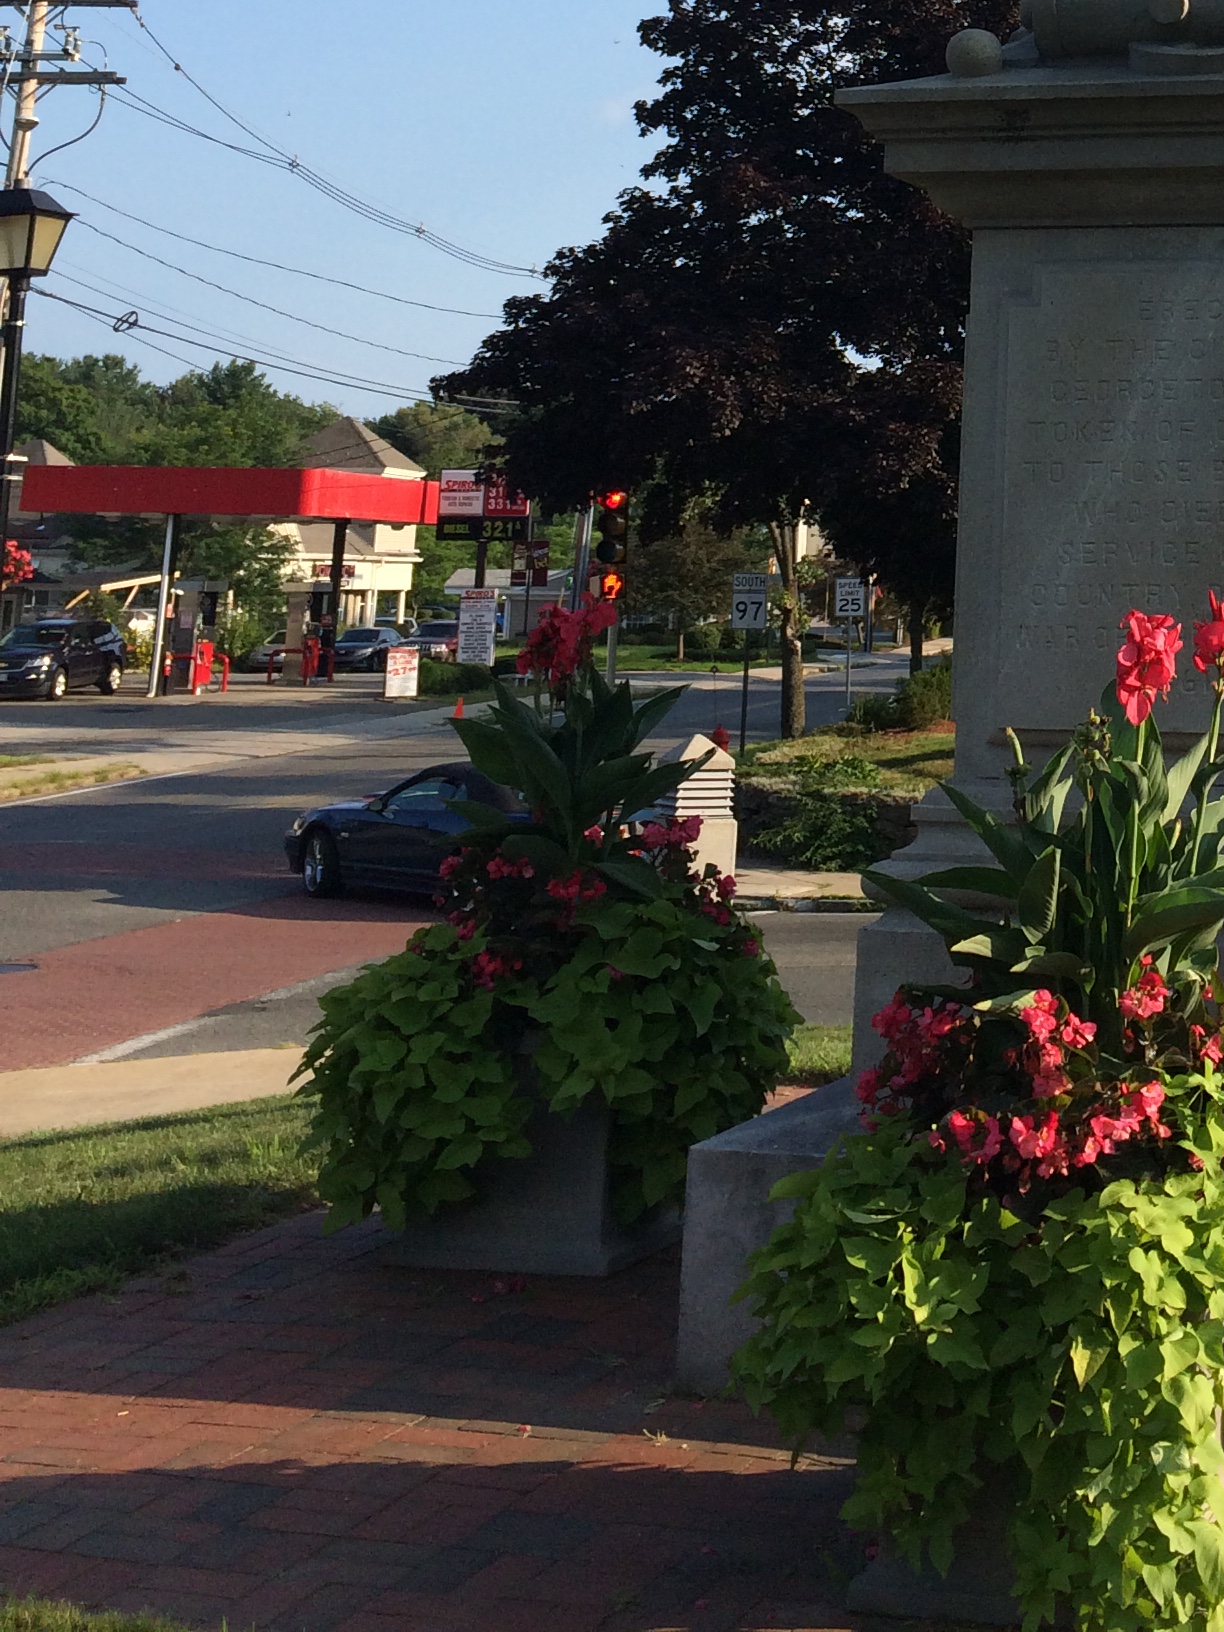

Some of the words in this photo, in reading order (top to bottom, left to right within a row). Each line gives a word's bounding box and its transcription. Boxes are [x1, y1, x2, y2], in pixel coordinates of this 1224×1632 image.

[1046, 338, 1085, 362] BY
[1106, 338, 1174, 361] THE
[1027, 420, 1139, 443] TOKEN
[1157, 420, 1196, 442] OF
[1022, 460, 1064, 483] TO
[1084, 460, 1192, 483] THOSE
[444, 480, 482, 492] SPIRO
[1074, 500, 1141, 525] WHO
[443, 524, 470, 534] DIESEL
[1059, 541, 1201, 566] SERVICE
[734, 575, 766, 587] SOUTH
[838, 598, 862, 613] 25
[1031, 583, 1189, 608] COUNTRY
[735, 601, 763, 621] 97
